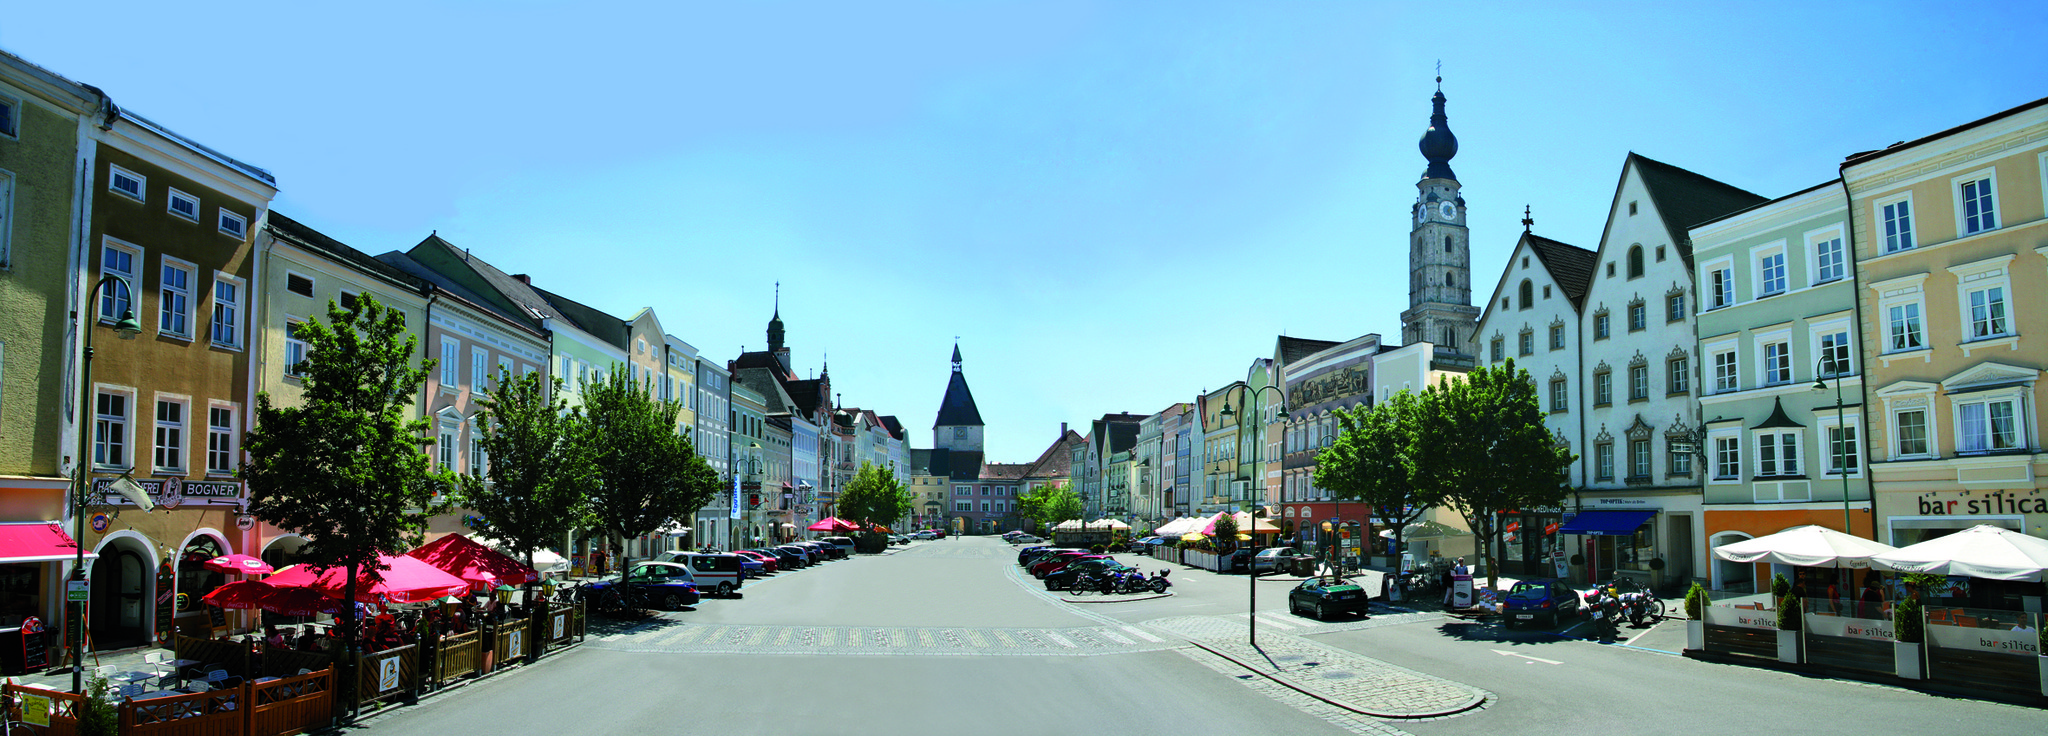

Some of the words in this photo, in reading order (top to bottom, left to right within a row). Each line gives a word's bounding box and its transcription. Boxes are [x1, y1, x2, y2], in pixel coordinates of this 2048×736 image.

[97, 481, 160, 494] HAUEREI
[186, 483, 235, 496] BOGNER
[1918, 496, 1958, 515] bar
[1967, 493, 2048, 514] silica
[1738, 616, 1751, 625] bar
[1753, 617, 1777, 627] silica
[1847, 625, 1863, 635] bar
[1865, 627, 1893, 638] silica
[1979, 638, 1999, 648] bar
[2002, 640, 2037, 652] silica
